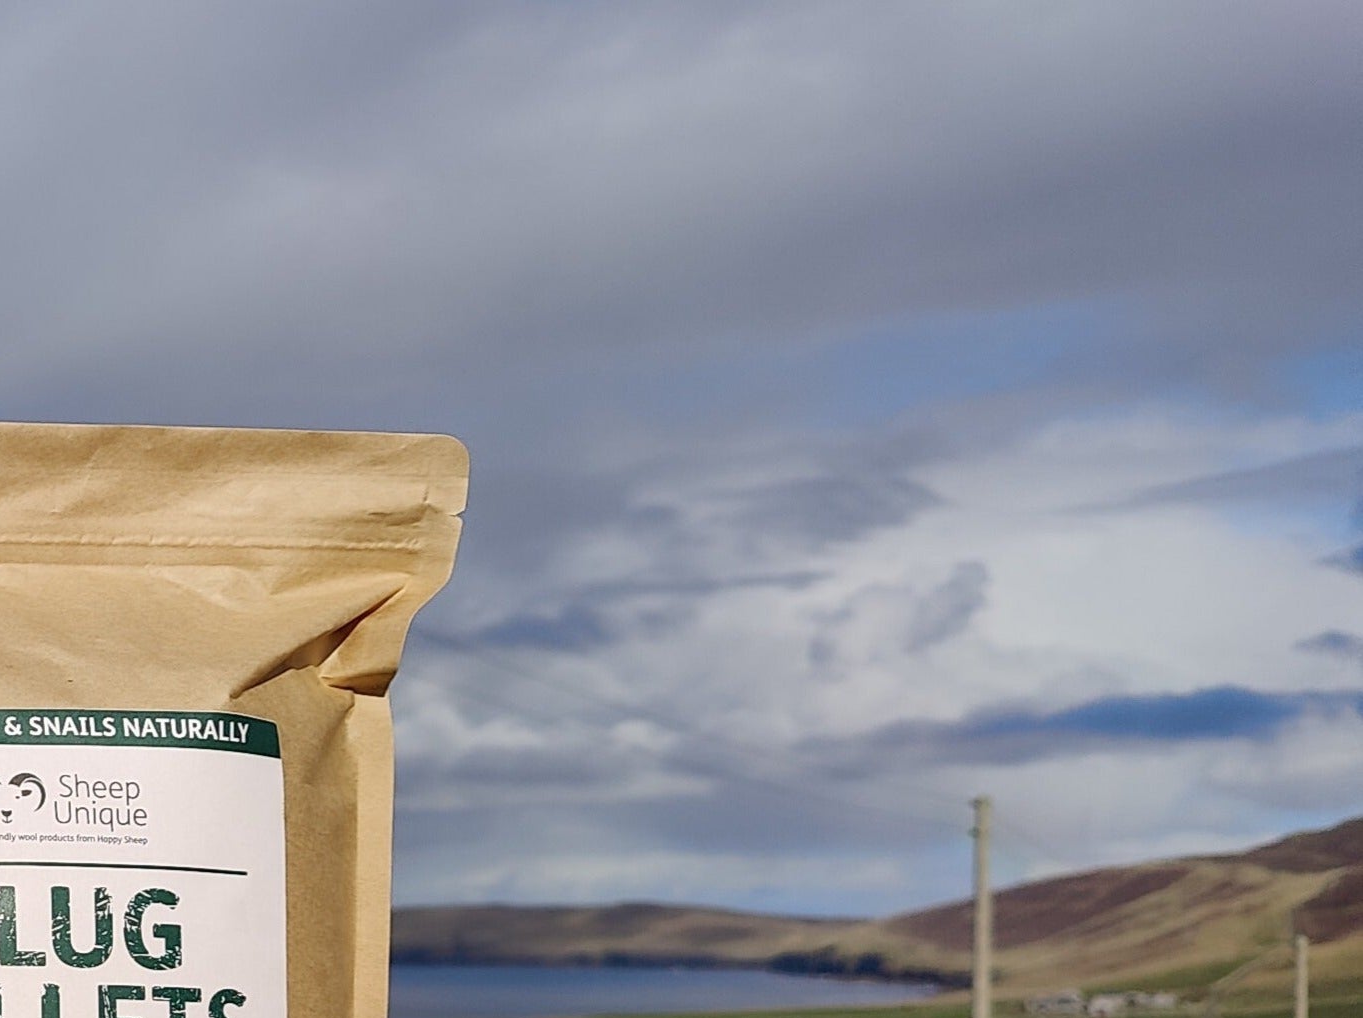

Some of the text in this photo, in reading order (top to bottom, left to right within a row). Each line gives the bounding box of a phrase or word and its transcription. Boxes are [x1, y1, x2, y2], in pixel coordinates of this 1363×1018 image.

[4, 716, 22, 736] &
[29, 716, 116, 737] SNAILS
[123, 717, 249, 743] NATURALLY
[59, 774, 141, 805] Sheep
[54, 801, 147, 832] Unique
[18, 833, 37, 841] wool
[39, 834, 74, 842] products
[98, 836, 122, 845] Happy
[124, 836, 148, 845] Sheep
